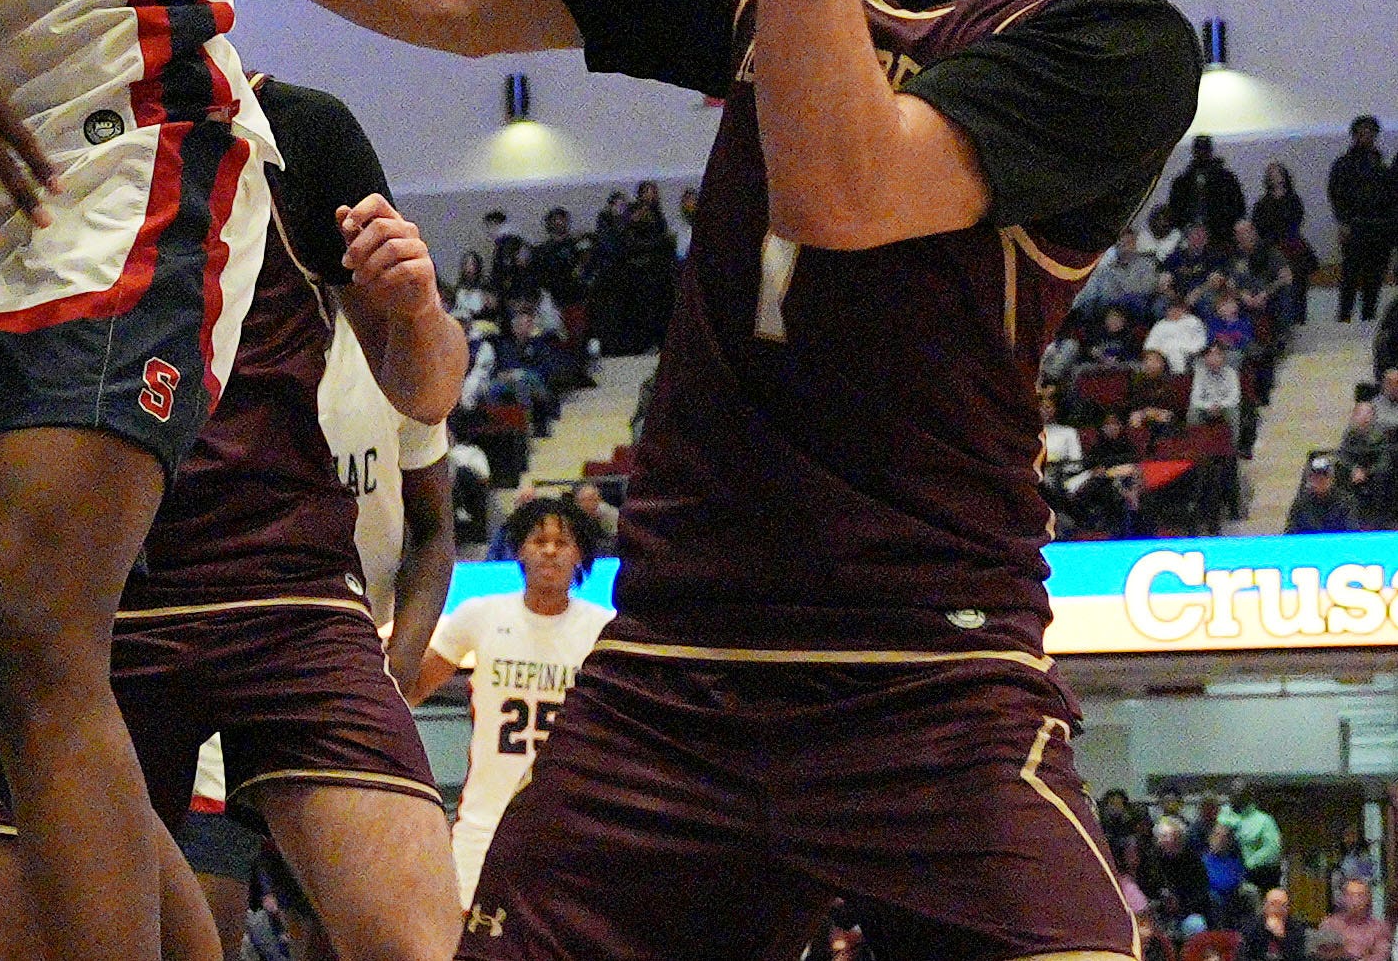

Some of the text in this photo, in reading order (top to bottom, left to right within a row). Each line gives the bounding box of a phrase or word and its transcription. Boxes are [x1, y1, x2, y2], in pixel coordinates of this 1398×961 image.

[138, 356, 181, 422] S
[333, 445, 378, 497] AC
[1124, 550, 1398, 642] Crus
